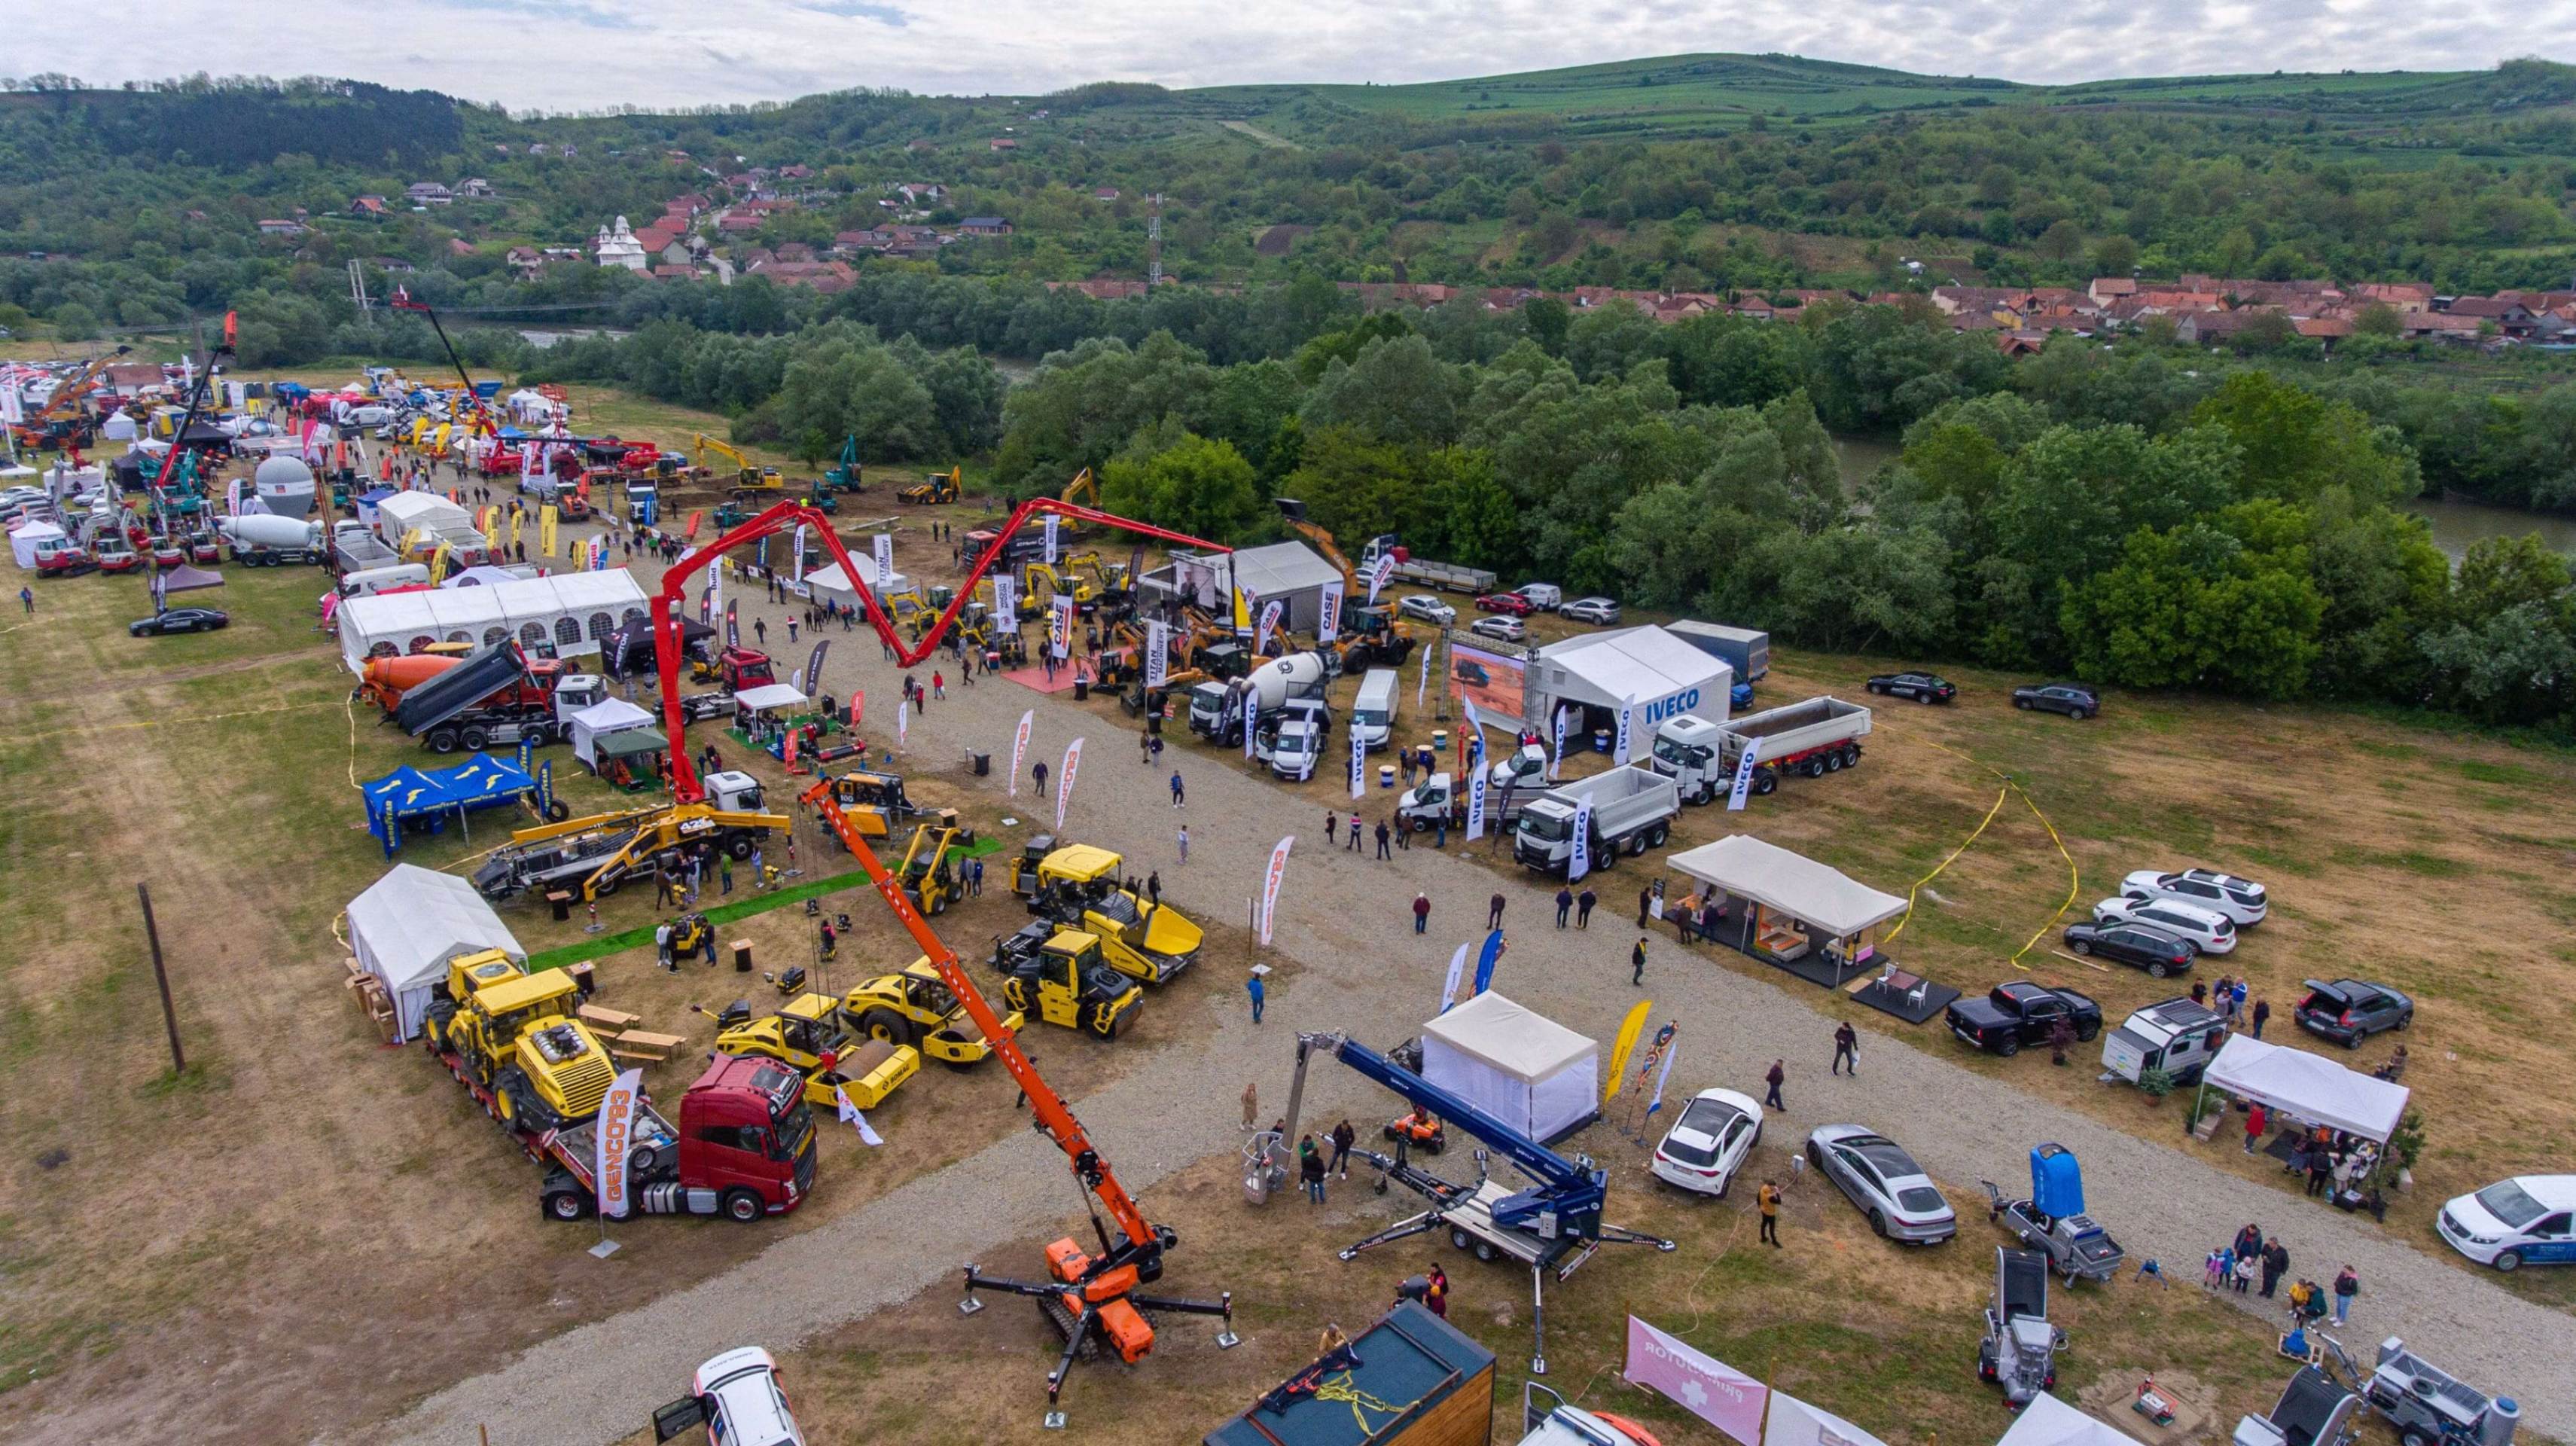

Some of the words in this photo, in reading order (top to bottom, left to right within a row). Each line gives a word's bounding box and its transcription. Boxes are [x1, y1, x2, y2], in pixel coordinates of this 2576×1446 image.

[1373, 559, 1389, 581] CASE
[1054, 603, 1064, 645] CASE
[1262, 605, 1276, 630] CASE
[1323, 591, 1334, 630] CASE
[1646, 688, 1699, 725] IVECO
[1620, 710, 1629, 750] IVECO
[1736, 752, 1754, 795] IVECO
[1473, 780, 1484, 825] IVECO
[1575, 810, 1587, 861] IVECO
[890, 1063, 910, 1084] BOMAG
[605, 1089, 630, 1202] GENCO'93
